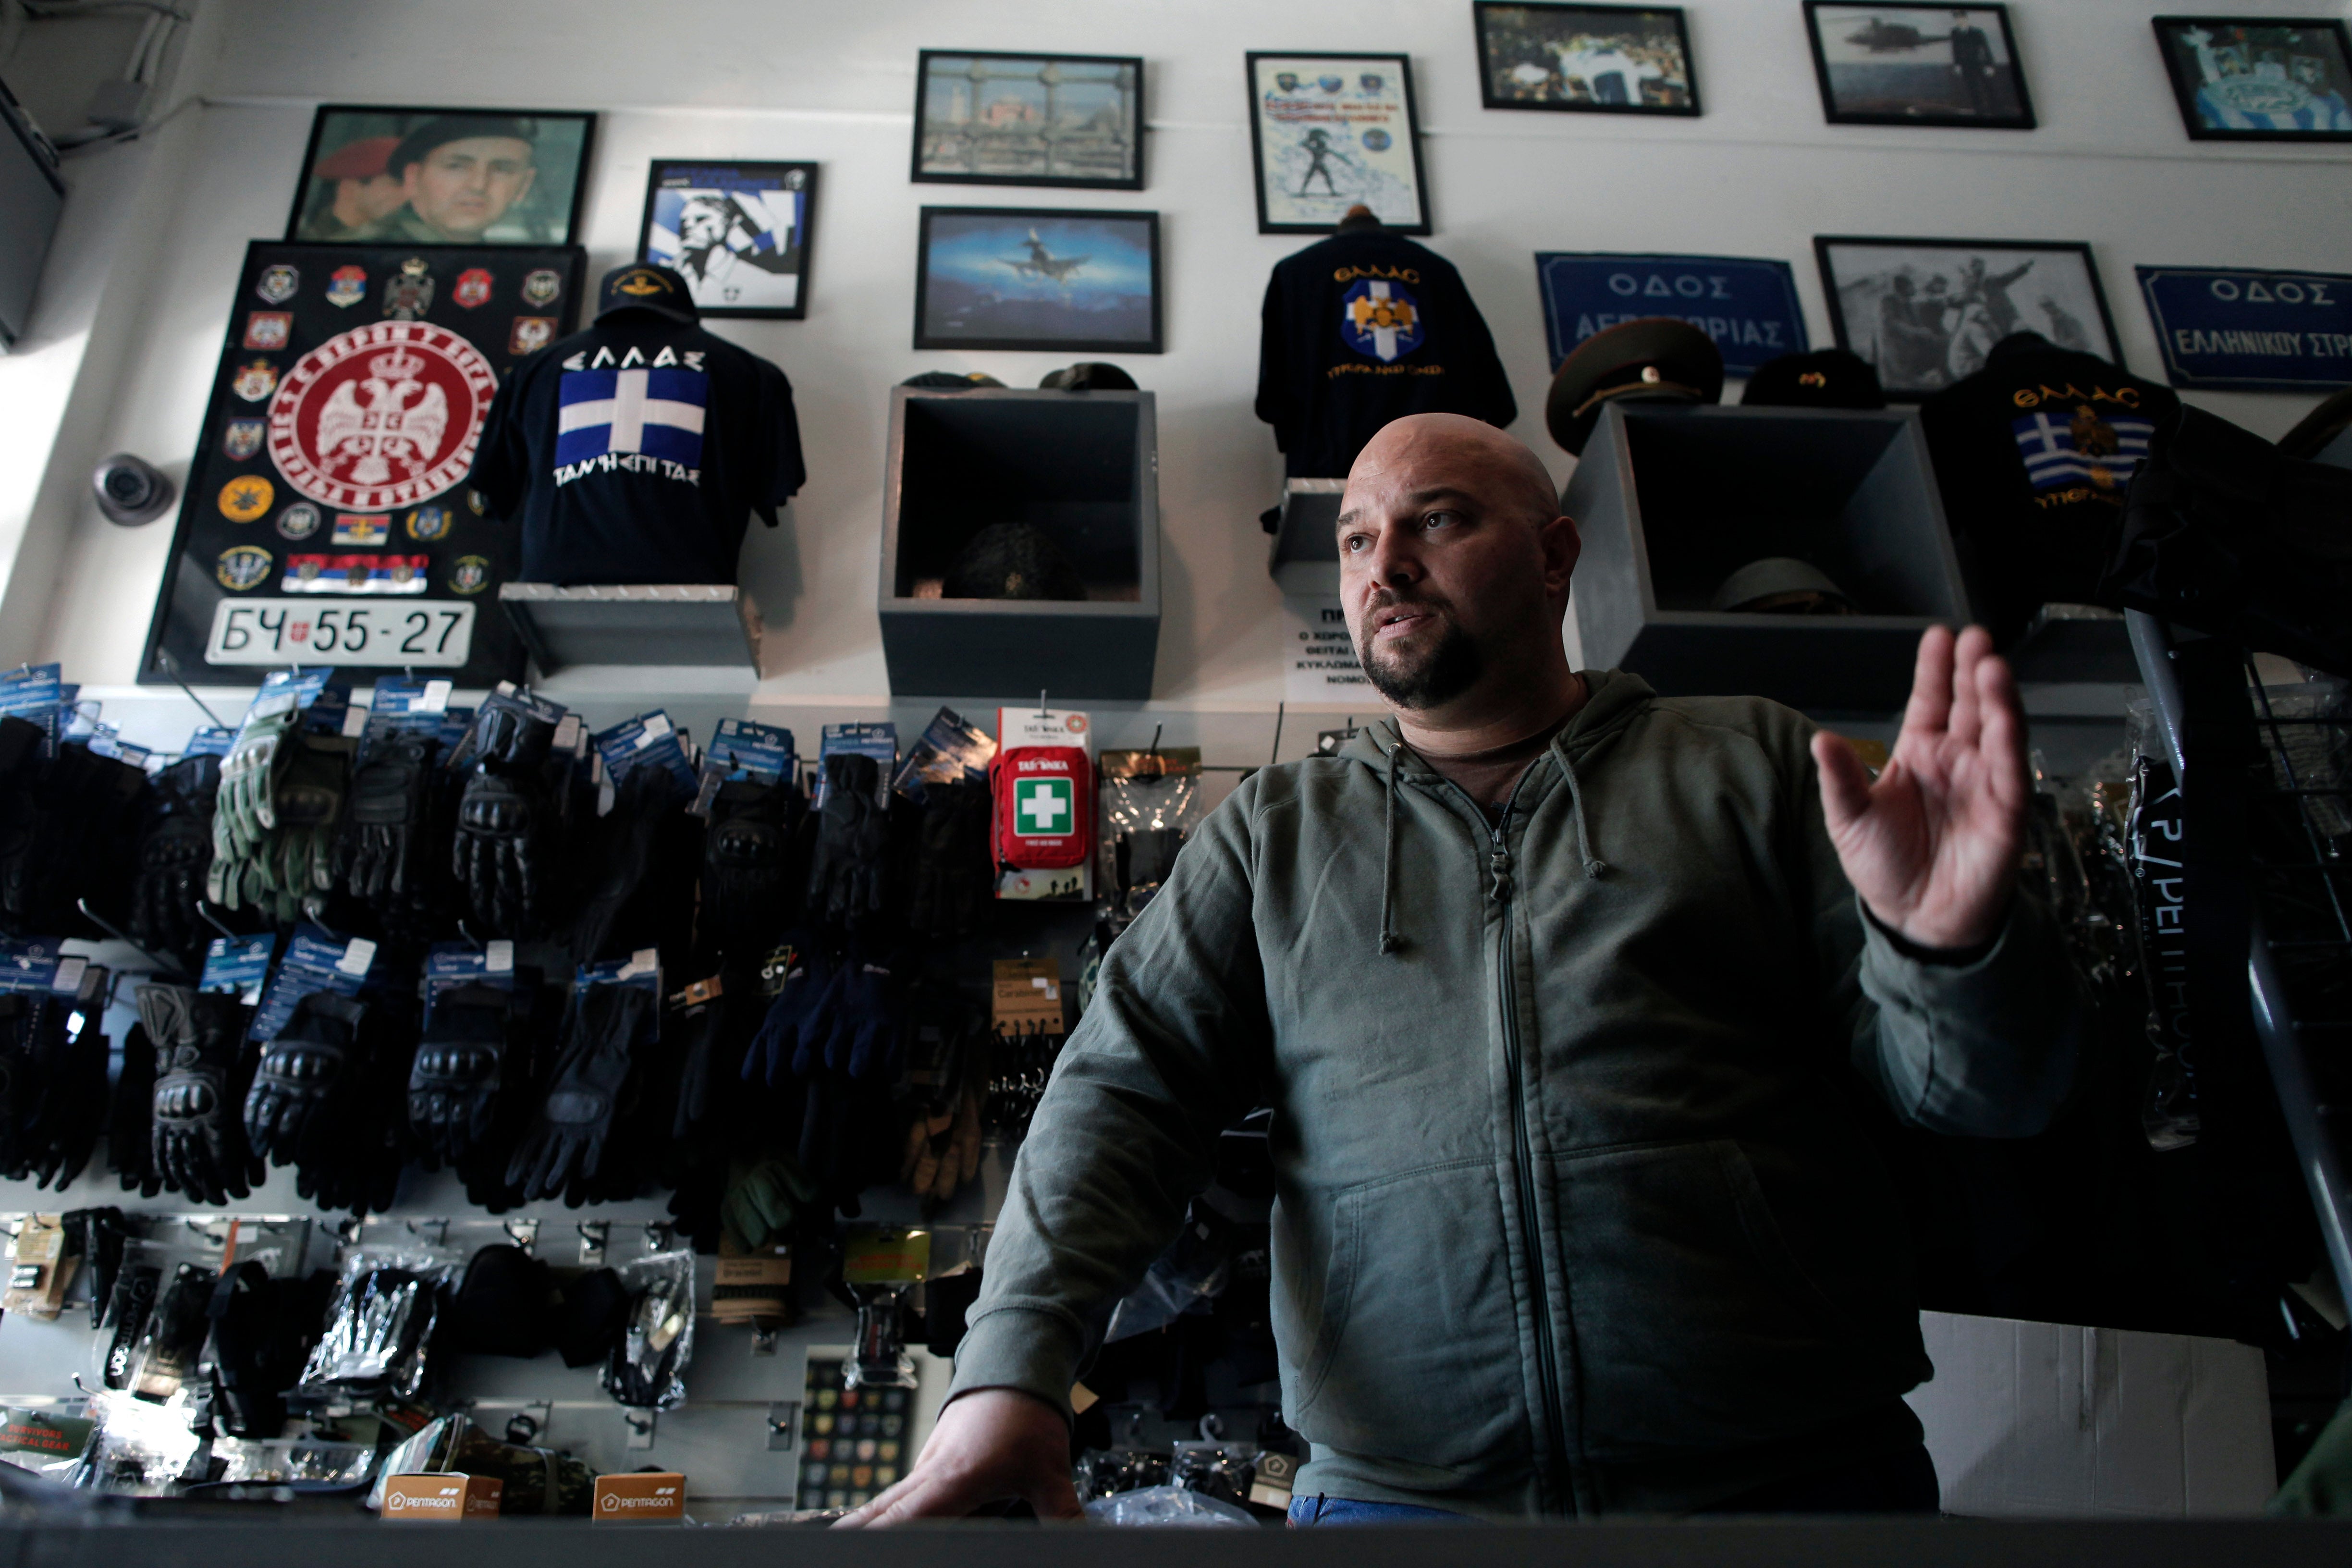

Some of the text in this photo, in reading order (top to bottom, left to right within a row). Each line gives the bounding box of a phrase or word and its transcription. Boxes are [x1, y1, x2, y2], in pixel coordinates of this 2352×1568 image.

[1608, 273, 1732, 300] ΟΔΟΣ
[2210, 278, 2336, 306] ΟΔΟΣ
[2175, 329, 2303, 356] ΕΛΛΗΝΙΚΟΥ
[562, 345, 706, 372] ΕΛΛΑΣ
[222, 609, 287, 650] БЧ
[0, 1432, 71, 1451] ACTICAL GEAR
[406, 1496, 457, 1508] PENTAGON
[621, 1497, 674, 1507] PENTAGON
